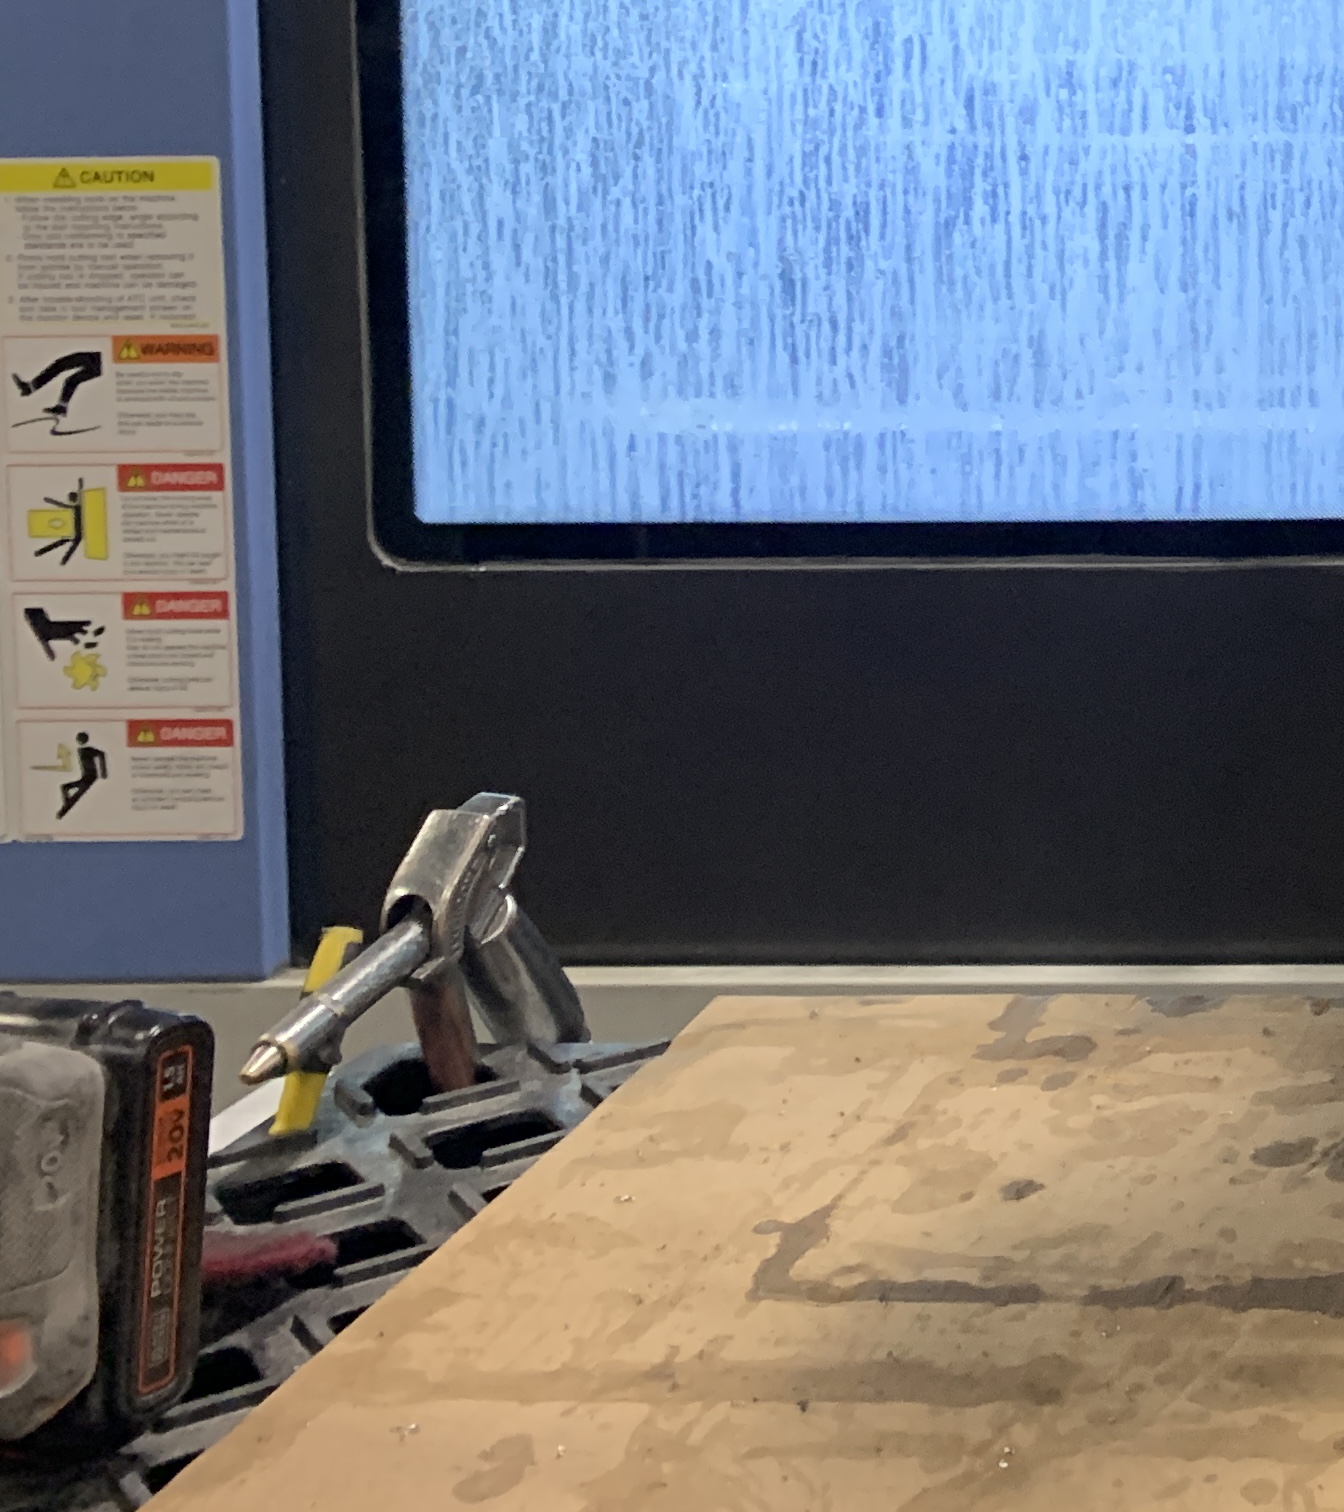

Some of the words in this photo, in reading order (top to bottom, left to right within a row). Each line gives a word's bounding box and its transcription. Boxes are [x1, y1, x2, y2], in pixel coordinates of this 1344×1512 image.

[80, 170, 155, 185] CAUTION
[141, 341, 215, 356] WARNING
[151, 470, 218, 486] DANGER
[155, 599, 223, 614] DANGER
[160, 726, 227, 742] DANGER
[166, 1107, 187, 1163] 20V
[150, 1198, 167, 1299] POWER
